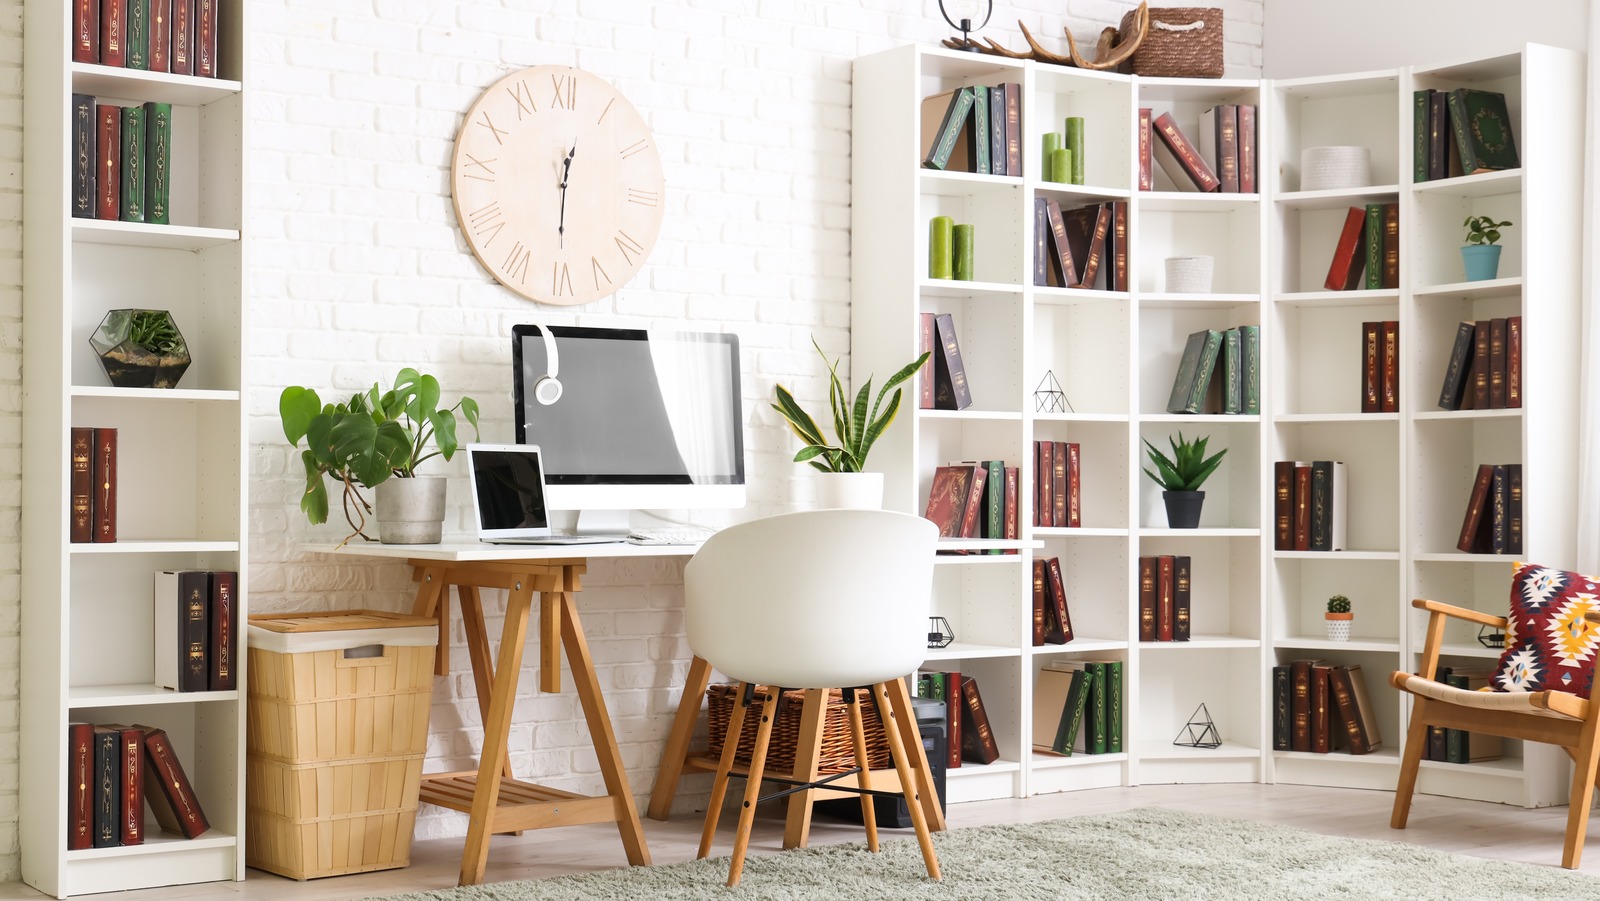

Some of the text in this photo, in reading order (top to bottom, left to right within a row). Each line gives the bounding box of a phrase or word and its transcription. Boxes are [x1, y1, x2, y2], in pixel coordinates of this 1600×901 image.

[507, 80, 537, 121] XI
[552, 74, 576, 111] XII
[477, 111, 509, 145] X
[598, 98, 615, 124] I
[620, 139, 648, 159] II
[464, 153, 497, 181] IX
[628, 188, 657, 207] III
[470, 201, 505, 248] VIII
[502, 241, 530, 284] VII
[614, 230, 644, 266] IV
[553, 262, 573, 296] VI
[592, 256, 612, 290] V
